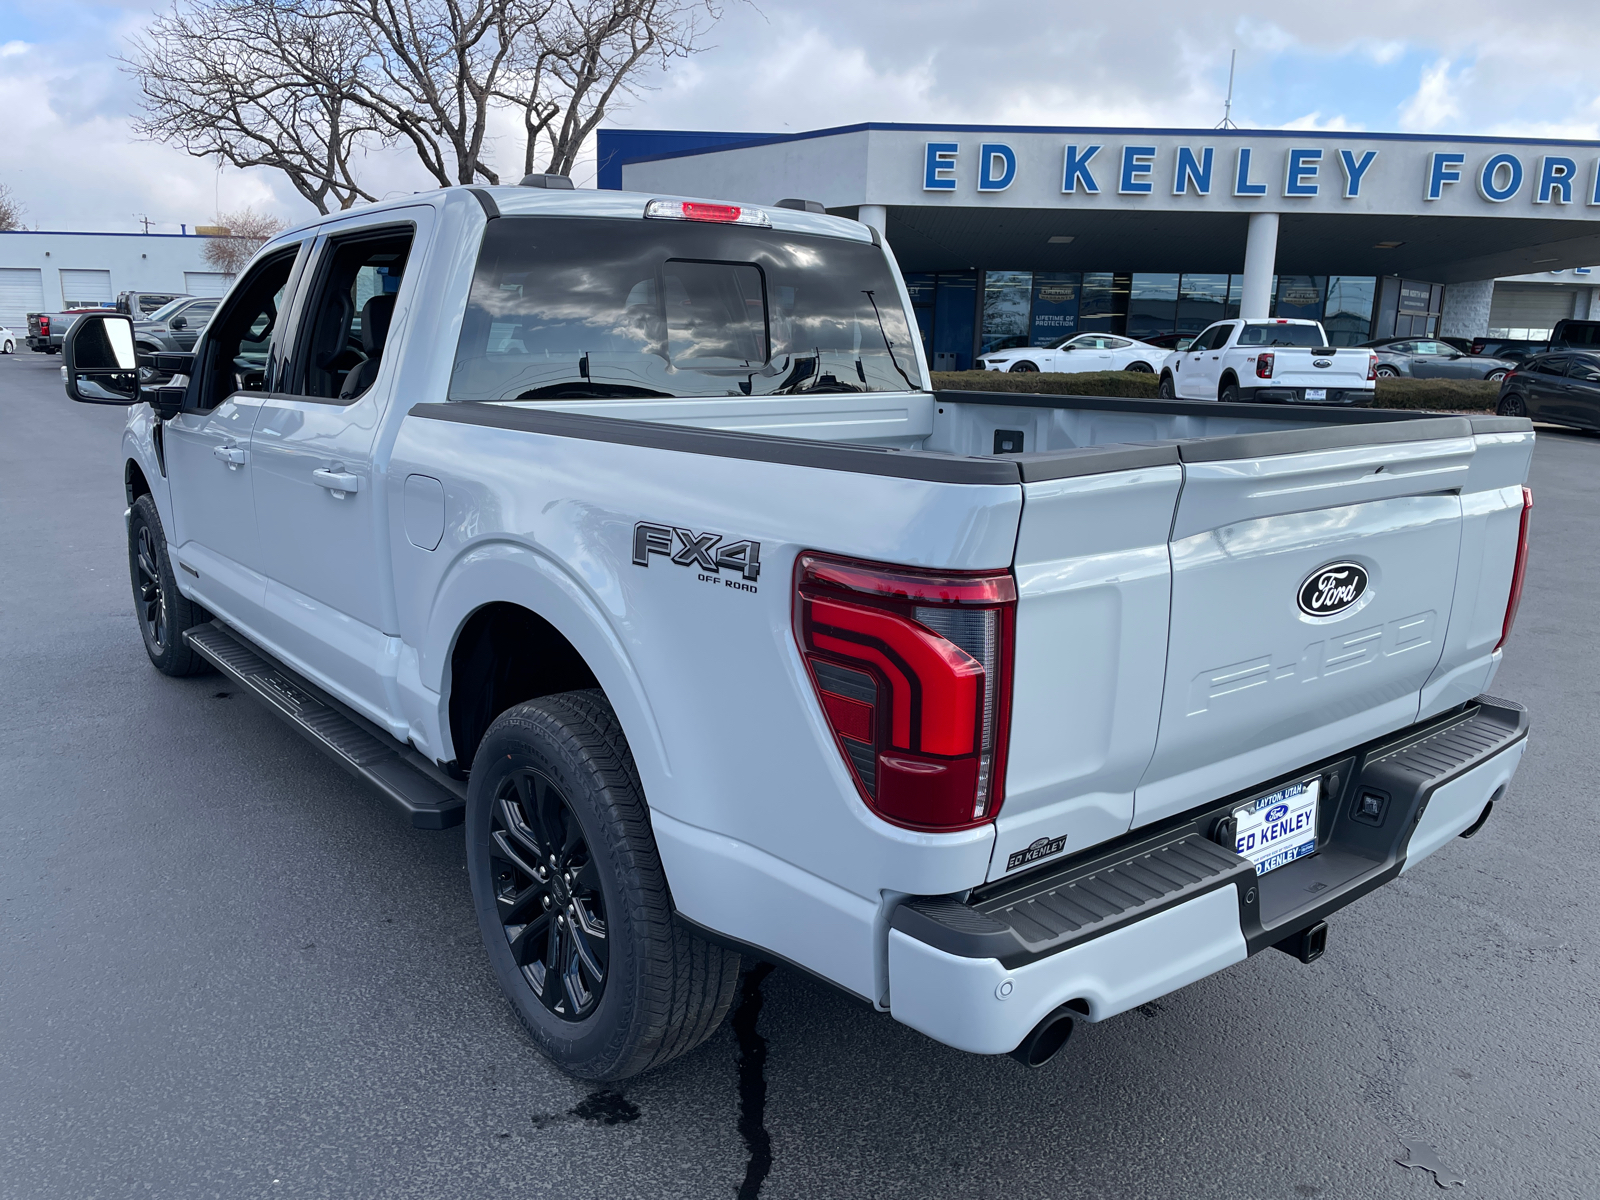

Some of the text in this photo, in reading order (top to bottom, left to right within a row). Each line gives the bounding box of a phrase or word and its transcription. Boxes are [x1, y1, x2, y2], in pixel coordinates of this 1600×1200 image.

[923, 142, 1018, 192] ED
[1061, 144, 1379, 198] KENLEY
[632, 521, 761, 582] FX4
[698, 573, 758, 594] OFF ROAD
[1311, 570, 1359, 609] Ford
[1186, 609, 1438, 717] F-150
[1256, 784, 1302, 808] LAYTON, UTAH
[1237, 809, 1312, 854] ED KENLEY
[1009, 855, 1023, 868] ED
[1025, 839, 1065, 862] KENLEY
[1255, 863, 1262, 874] D
[1264, 846, 1299, 872] KENLEY
